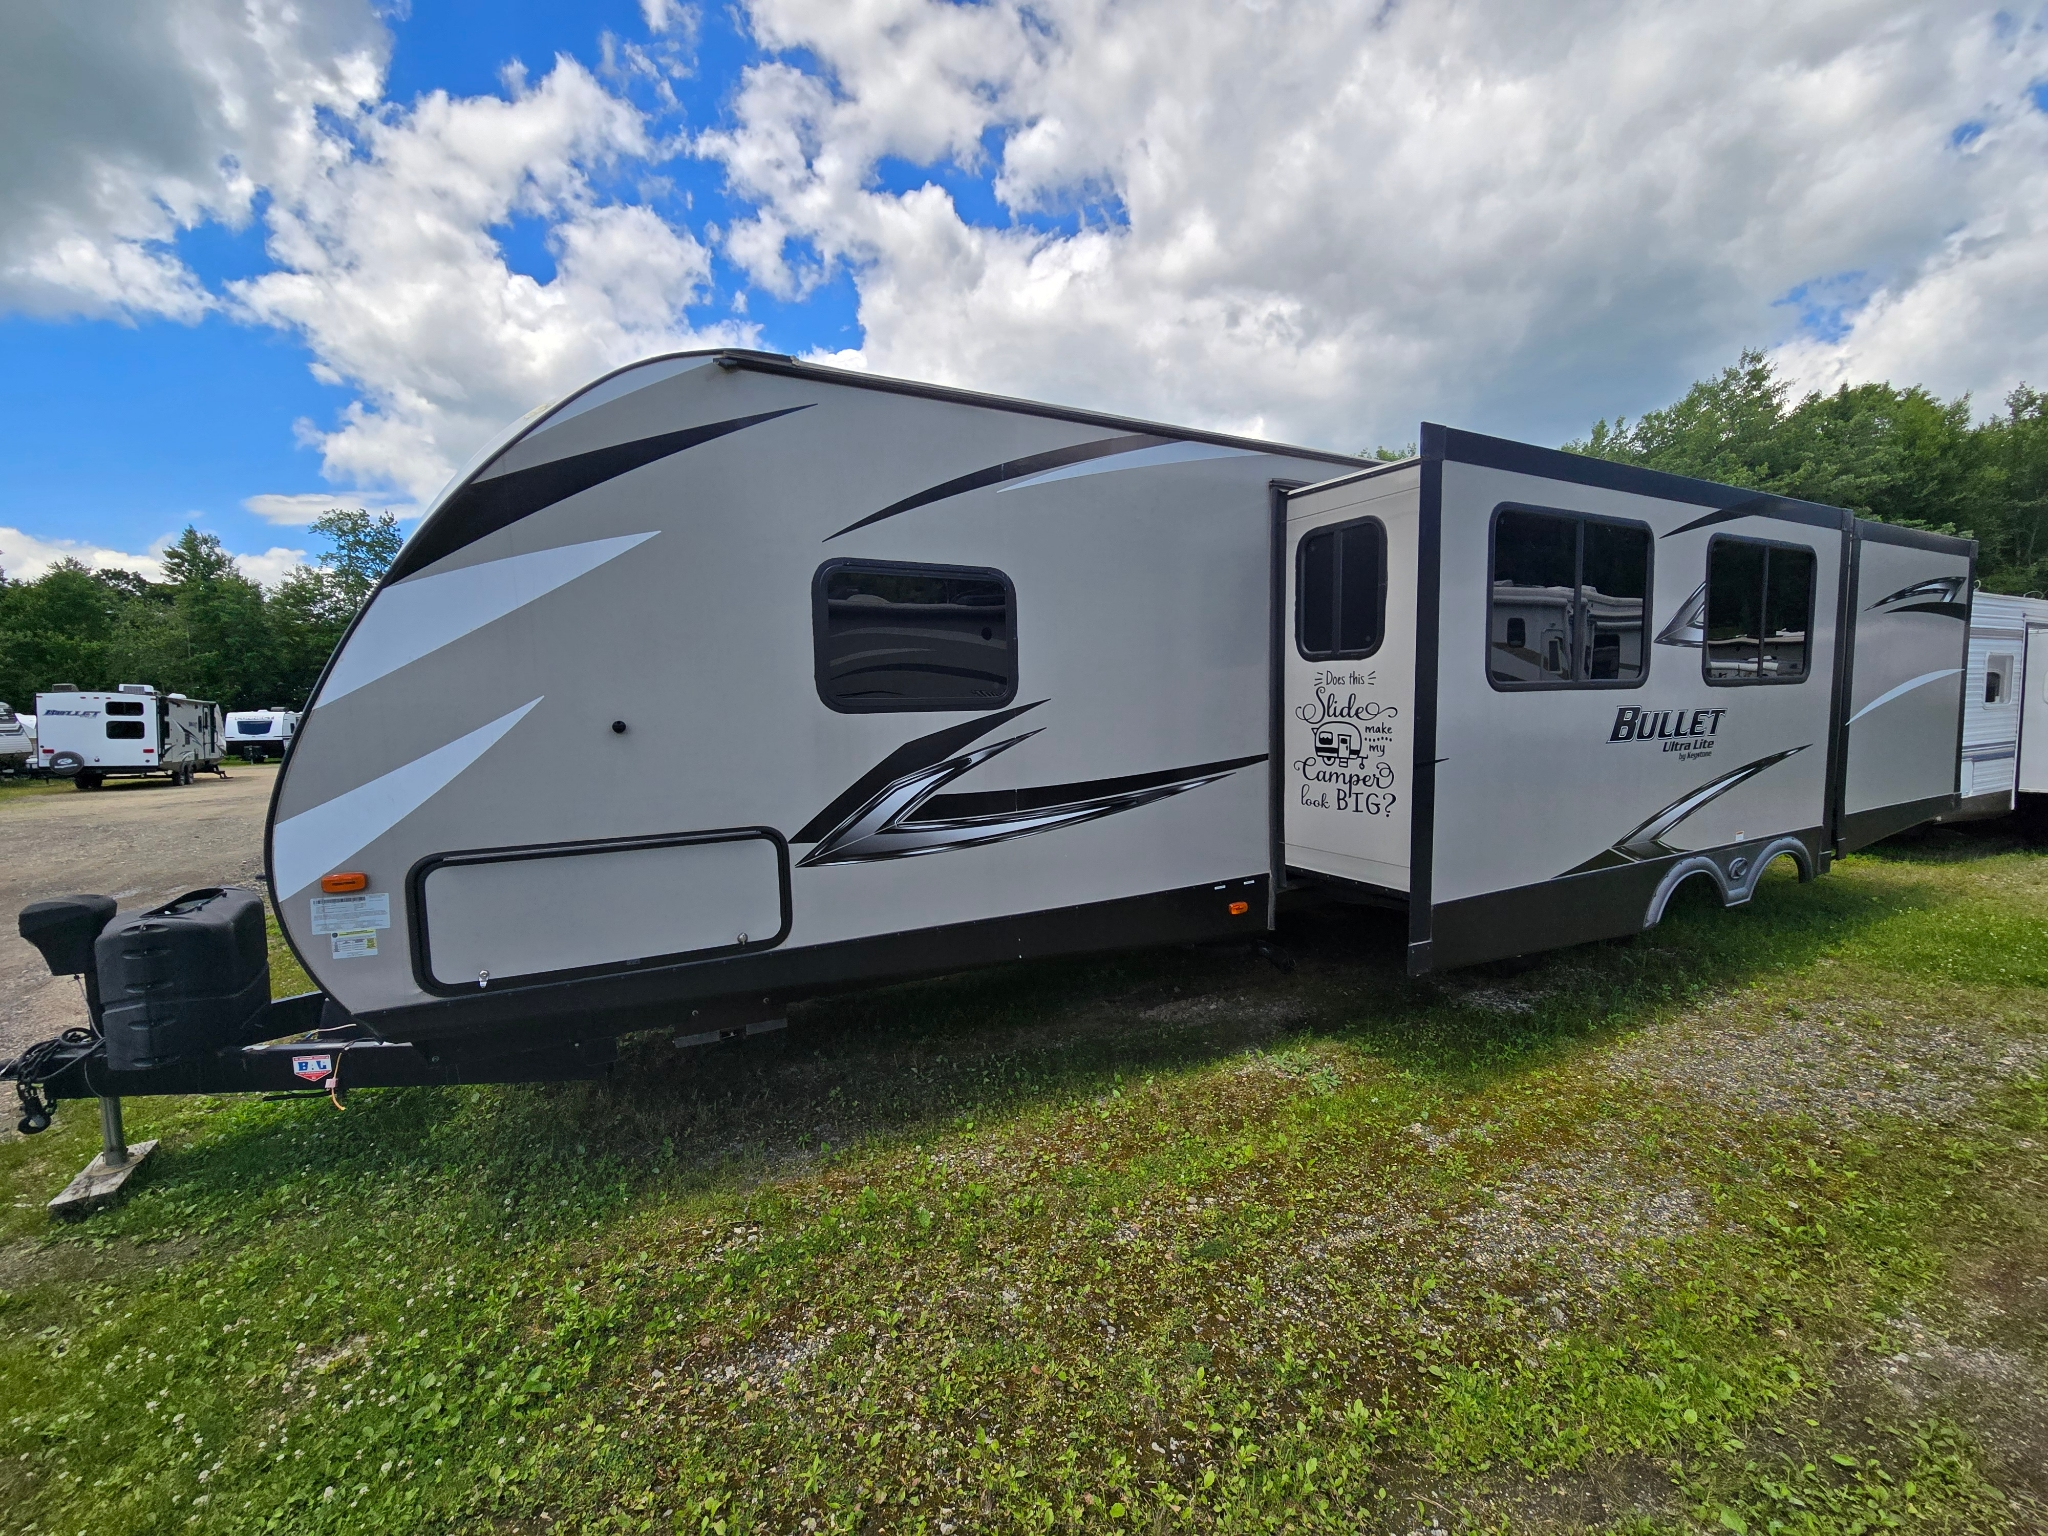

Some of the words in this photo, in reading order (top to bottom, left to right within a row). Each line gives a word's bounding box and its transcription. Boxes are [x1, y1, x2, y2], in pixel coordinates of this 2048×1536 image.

[1326, 670, 1345, 686] Does
[1349, 671, 1365, 685] this
[1295, 686, 1398, 724] Slide
[1365, 722, 1393, 734] make
[1606, 704, 1728, 744] BULLET
[1369, 744, 1385, 757] my
[1662, 741, 1691, 752] Ultra
[1693, 739, 1714, 750] Lite
[1678, 752, 1686, 761] by
[1293, 756, 1394, 798] Camper
[1301, 784, 1330, 809] look
[1336, 788, 1397, 818] BIG?
